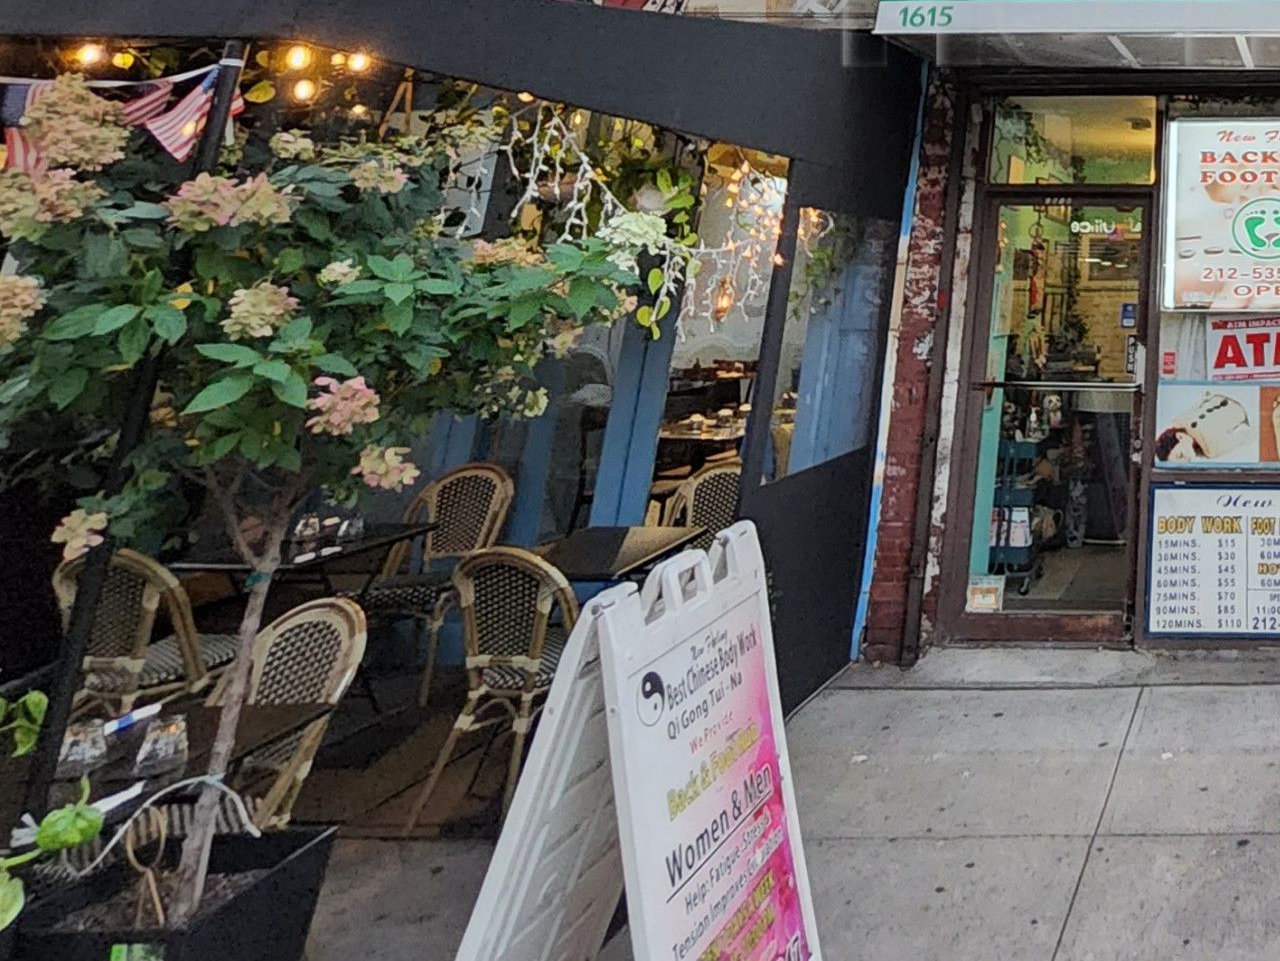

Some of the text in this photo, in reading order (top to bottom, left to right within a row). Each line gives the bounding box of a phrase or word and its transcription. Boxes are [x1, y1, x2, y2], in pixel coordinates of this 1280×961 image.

[898, 5, 954, 28] 1615
[1217, 130, 1256, 143] New
[1200, 150, 1280, 164] BACK
[1200, 170, 1279, 183] FOOT
[1216, 494, 1273, 508] New
[1157, 516, 1243, 534] BODY WORK
[1251, 517, 1276, 535] FOOT
[1217, 539, 1236, 548] $15
[1217, 552, 1236, 561] $30
[1217, 565, 1236, 575] $45
[1217, 592, 1236, 601] $70
[1217, 619, 1242, 629] $110
[666, 623, 758, 711] Best Chinese Body Work
[667, 716, 680, 740] Qi
[681, 699, 709, 729] Gong
[665, 765, 771, 888] Women & Men
[672, 914, 710, 961] Tension
